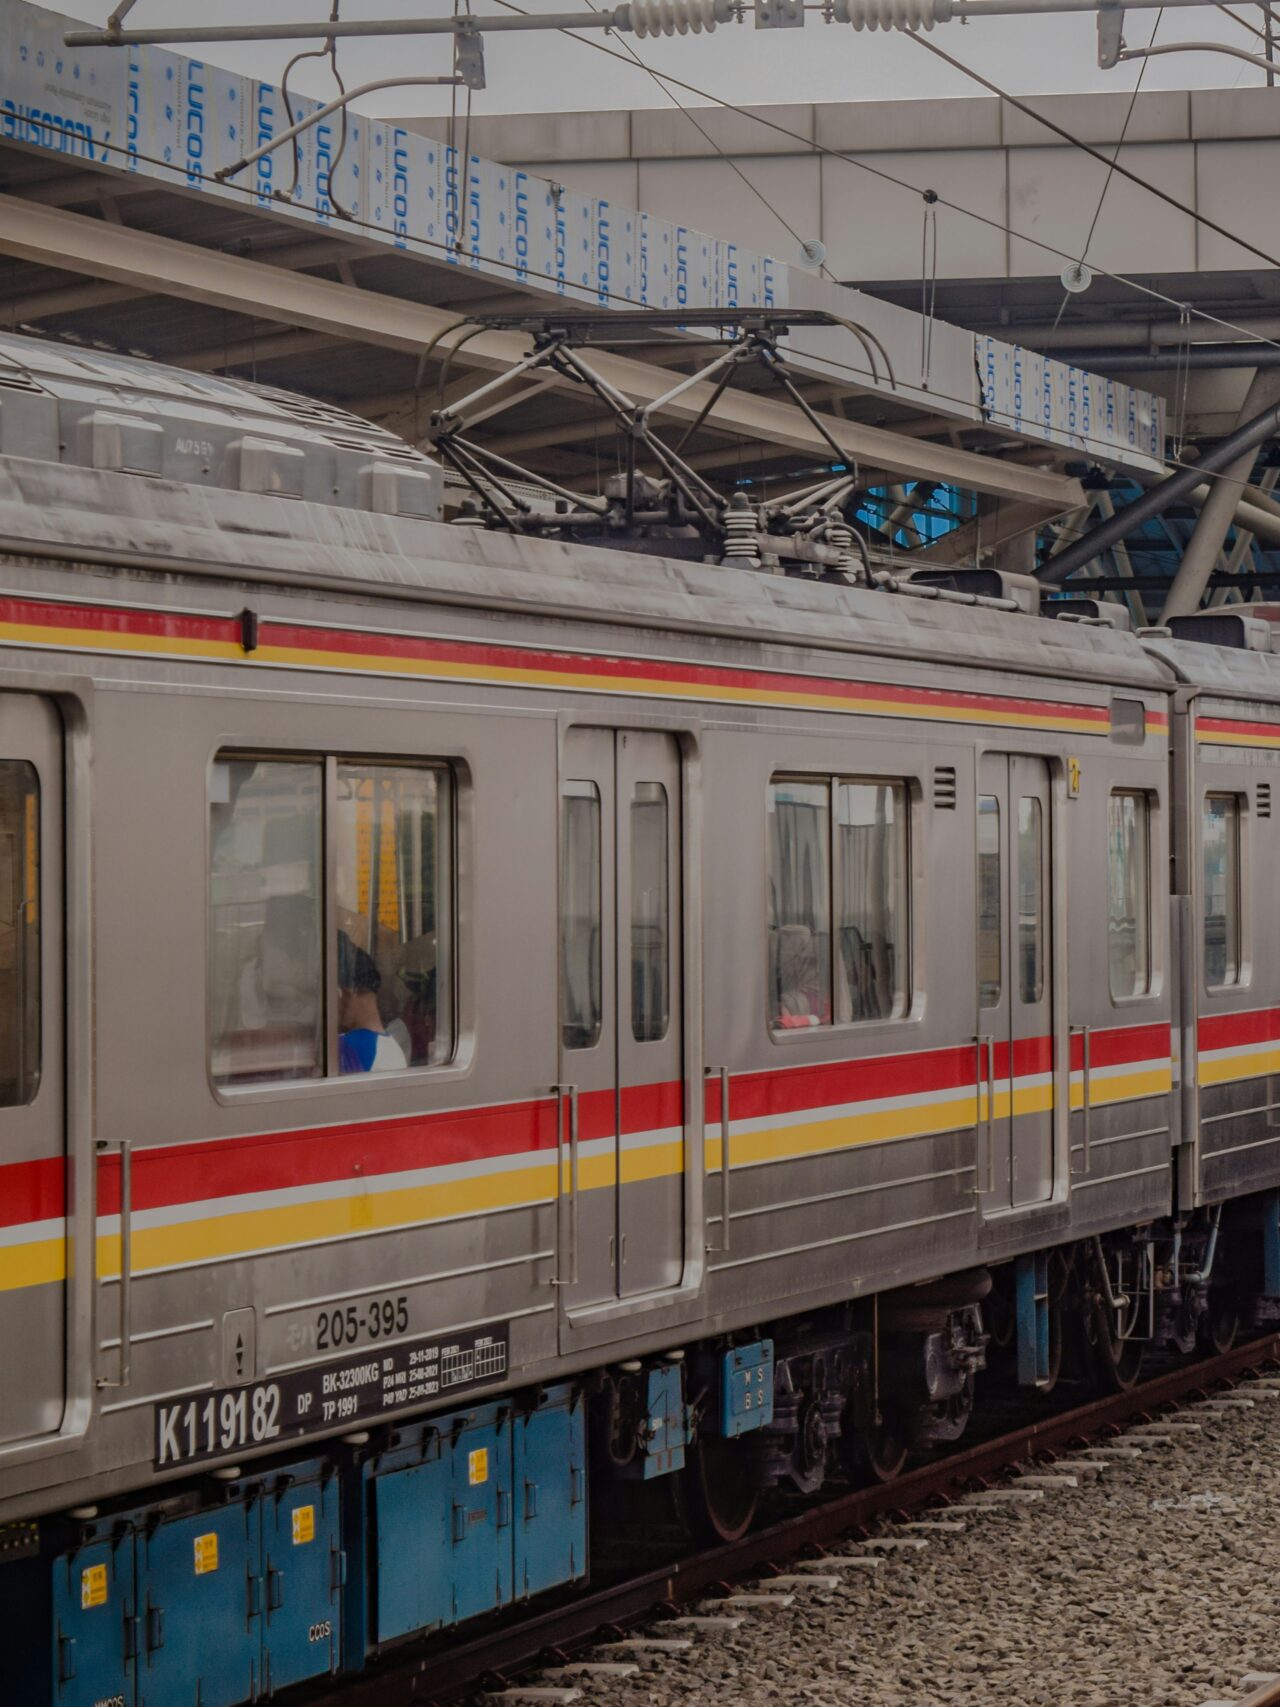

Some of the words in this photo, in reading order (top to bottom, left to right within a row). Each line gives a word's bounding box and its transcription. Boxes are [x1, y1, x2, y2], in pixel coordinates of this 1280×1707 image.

[317, 1297, 408, 1350] 205-395
[322, 1362, 379, 1394] BK-32300KG
[297, 1393, 312, 1415] DP
[321, 1401, 335, 1421] TP
[337, 1395, 358, 1419] 1991
[308, 1620, 331, 1642] CCOS
